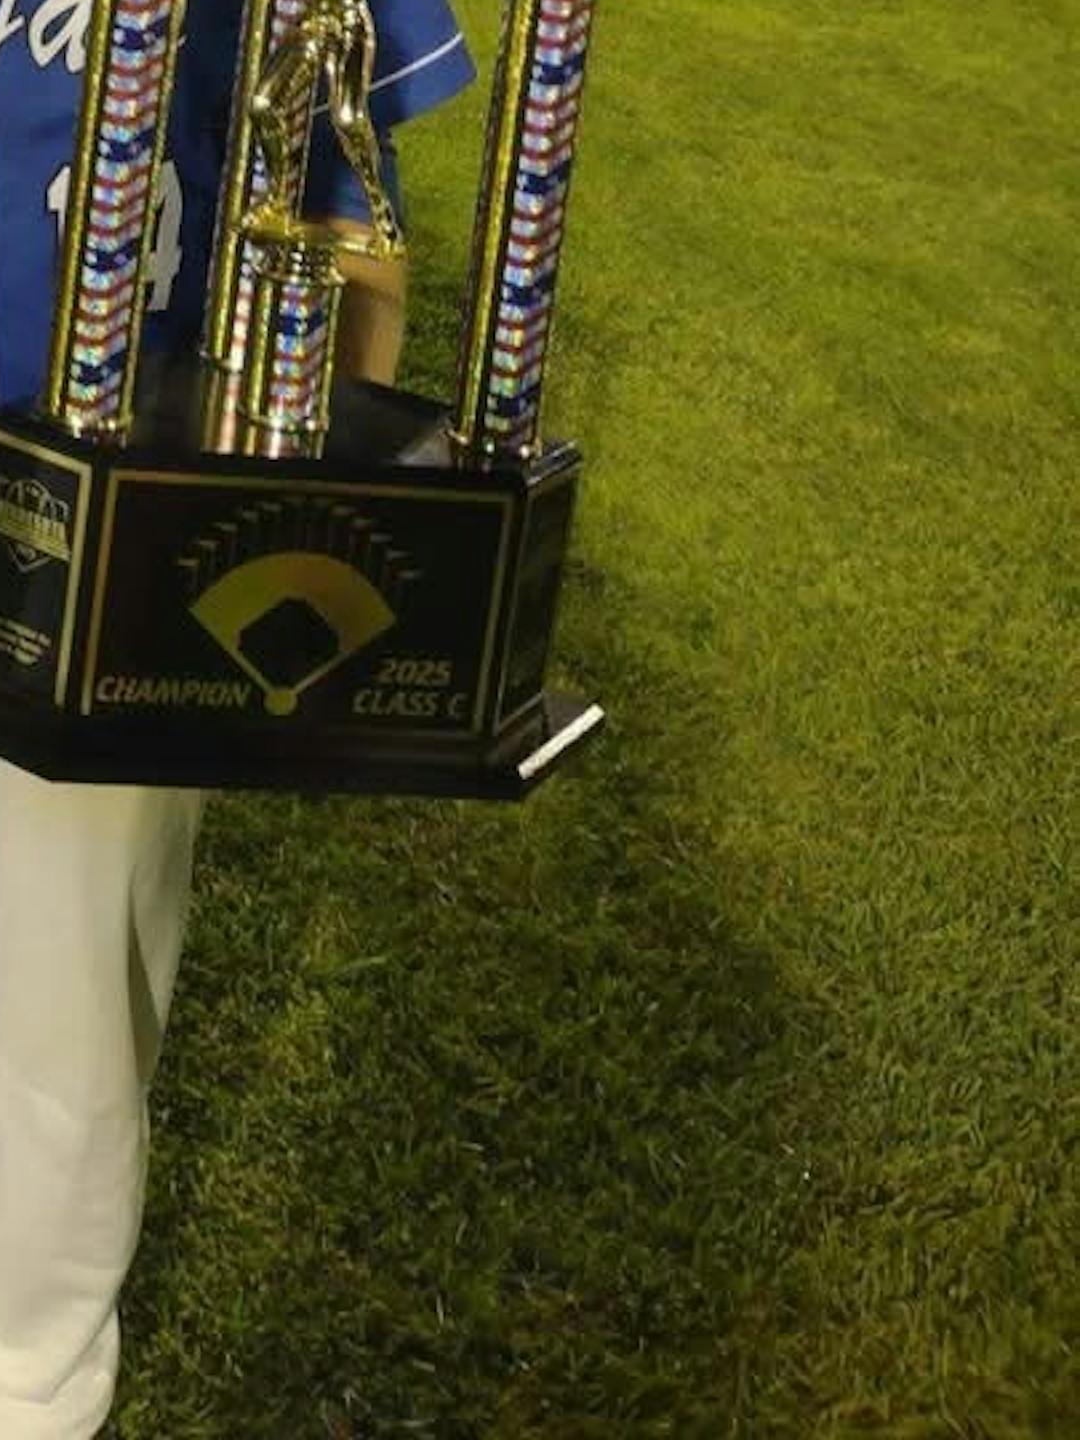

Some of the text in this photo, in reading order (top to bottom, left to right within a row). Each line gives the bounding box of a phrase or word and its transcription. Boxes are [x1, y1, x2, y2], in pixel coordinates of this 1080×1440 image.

[375, 657, 453, 687] 2025
[94, 674, 255, 709] CHAMPION
[351, 688, 469, 719] CLASS C
